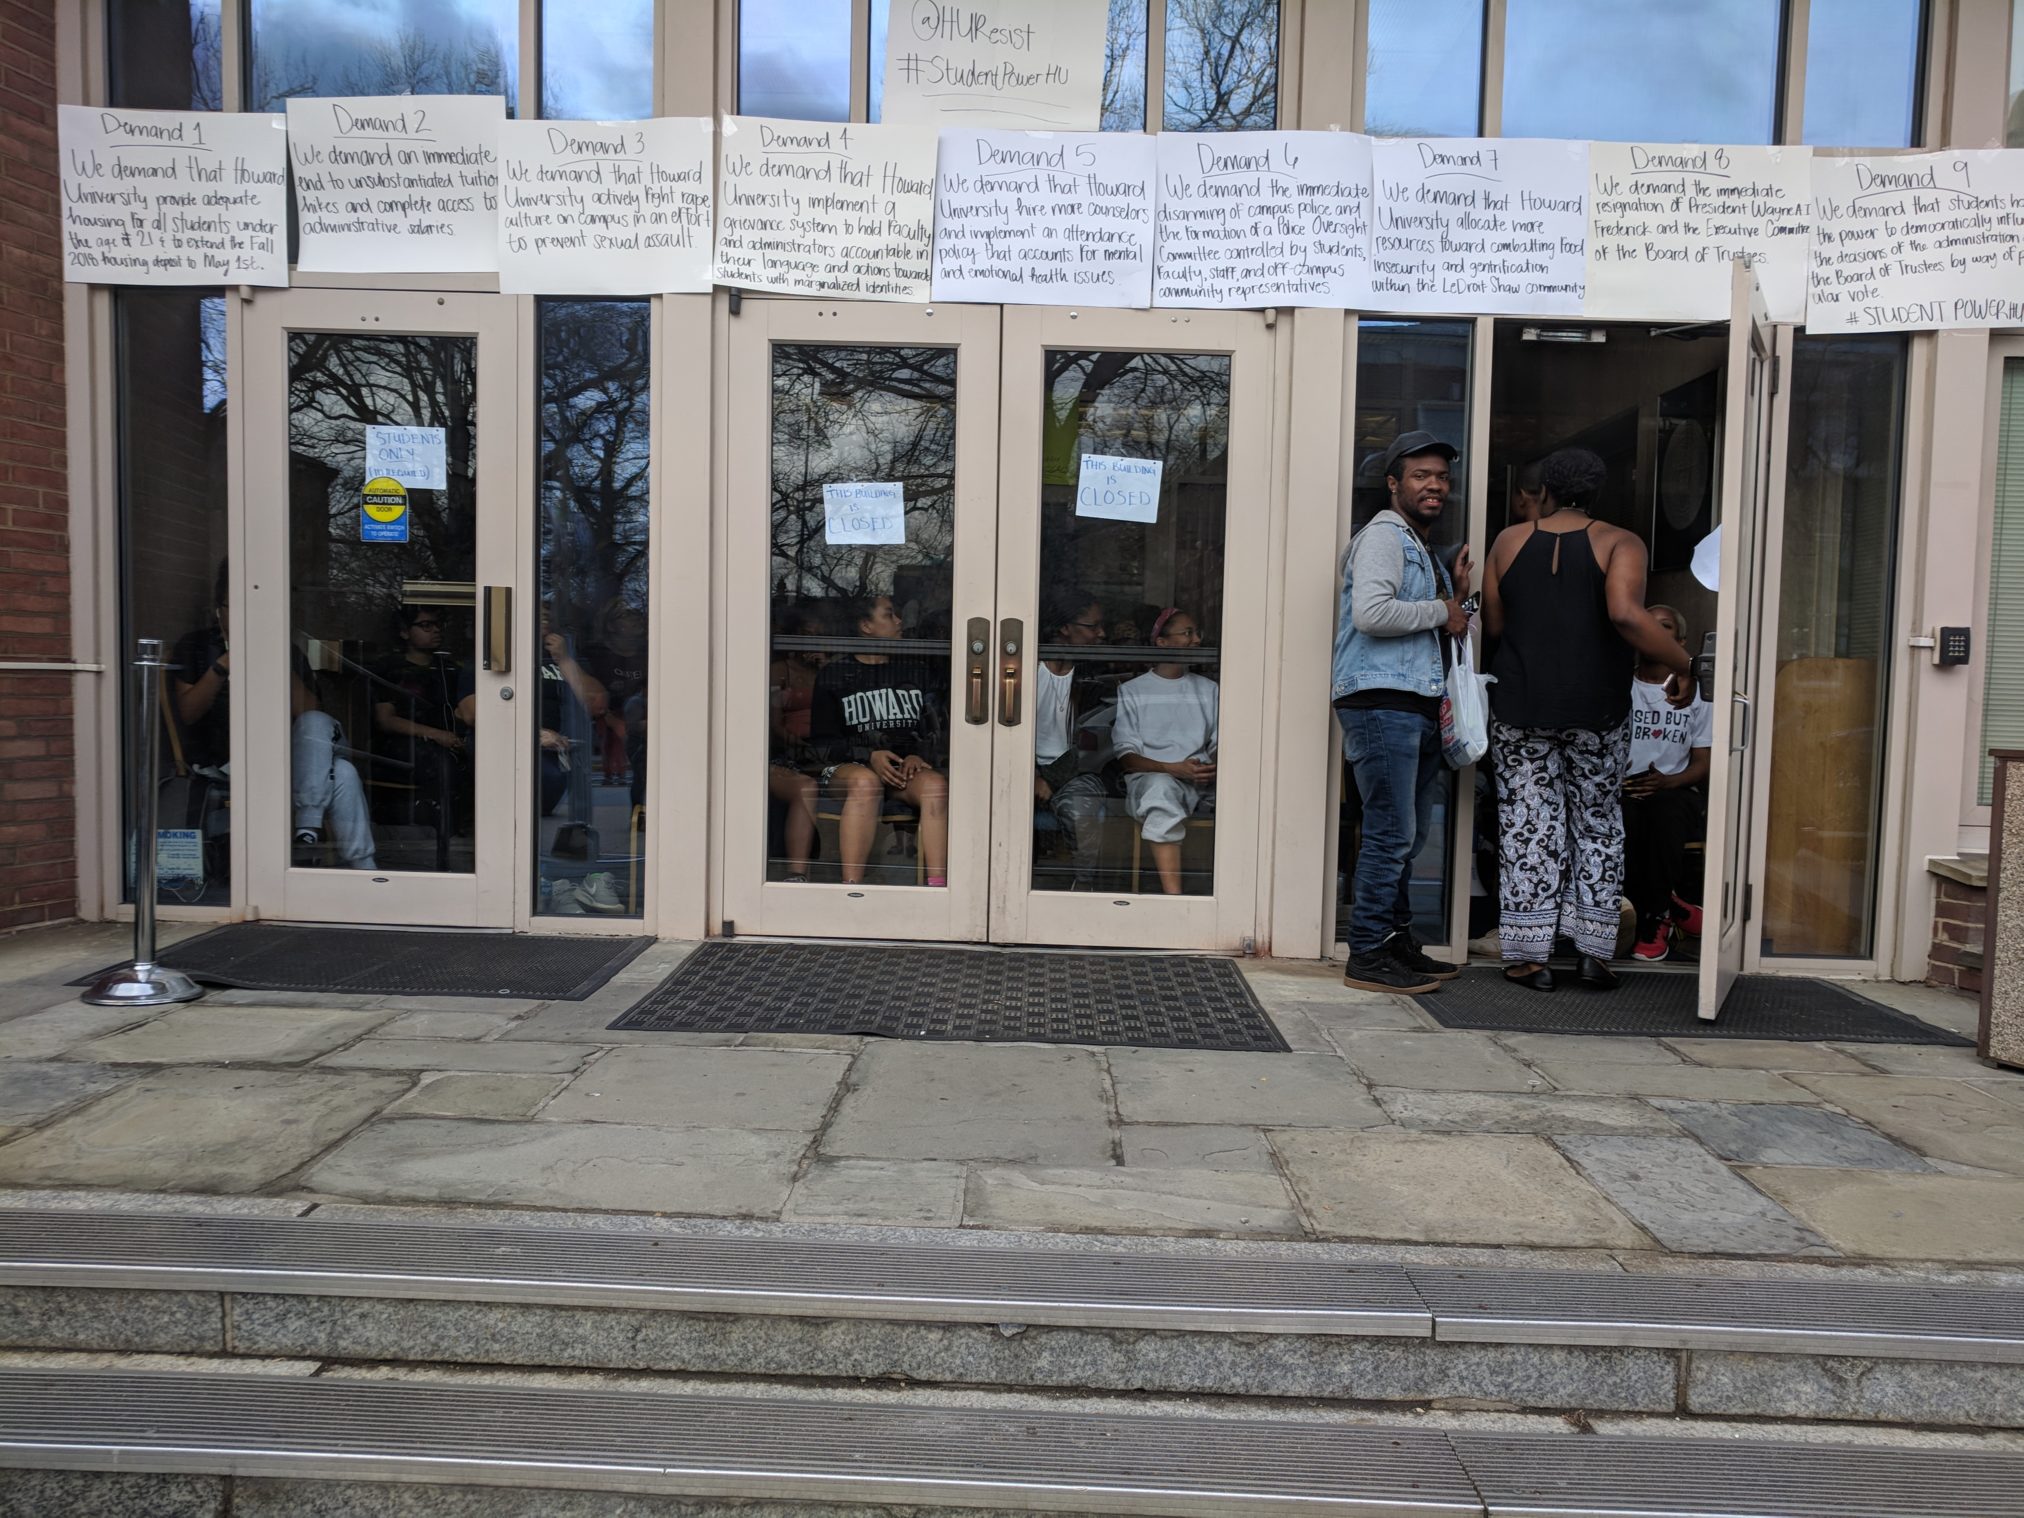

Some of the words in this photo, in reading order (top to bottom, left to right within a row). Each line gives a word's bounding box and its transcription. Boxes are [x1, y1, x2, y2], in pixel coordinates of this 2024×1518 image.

[912, 0, 1036, 51] @HUResist
[101, 113, 183, 141] Demand
[192, 122, 206, 145] 1
[332, 104, 408, 134] Demand
[414, 110, 432, 133] 2
[548, 128, 626, 155] Demand
[635, 132, 645, 154] 3
[761, 125, 829, 149] Demand
[839, 127, 854, 150] 4
[293, 142, 323, 165] We
[329, 143, 393, 166] demand
[398, 149, 418, 165] an
[423, 143, 497, 165] immediate
[977, 139, 1065, 170] Demand
[1076, 143, 1096, 167] 5
[1198, 142, 1270, 174] Demand
[1285, 142, 1299, 170] 6
[1418, 143, 1482, 169] Demand
[1487, 149, 1498, 170] 7
[1631, 146, 1707, 170] Demand
[1715, 148, 1730, 170] 8
[71, 149, 104, 178] We
[112, 156, 175, 180] demand
[185, 156, 224, 182] that
[235, 157, 285, 186] Howard
[507, 160, 530, 182] We
[537, 162, 602, 184] demand
[609, 163, 643, 185] that
[650, 160, 702, 184] Howard
[726, 154, 753, 177] We
[759, 158, 831, 182] demand
[838, 160, 873, 188] that
[882, 161, 933, 200] Howard
[1856, 163, 1936, 190] Demand
[1953, 161, 1970, 188] 9
[64, 179, 147, 209] University
[156, 193, 196, 212] provide
[203, 190, 261, 211] adequate
[943, 173, 969, 193] We
[974, 174, 1039, 195] demand
[1047, 173, 1080, 195] that
[1088, 173, 1145, 200] Howard
[1165, 173, 1192, 200] We
[1198, 177, 1260, 198] demand
[1270, 179, 1292, 198] the
[1297, 181, 1370, 198] immediate
[1383, 179, 1409, 203] We
[1416, 182, 1475, 209] demand
[1484, 190, 1510, 211] that
[1521, 190, 1582, 215] Howard
[1595, 173, 1623, 196] We
[1629, 177, 1685, 195] demand
[1692, 179, 1712, 198] the
[1717, 181, 1786, 198] immediate
[301, 196, 339, 213] hikes
[346, 198, 373, 213] and
[377, 194, 431, 218] complete
[438, 197, 474, 213] access
[483, 192, 497, 210] to
[504, 185, 584, 218] University
[592, 188, 640, 213] actively
[681, 192, 710, 212] rape
[724, 181, 800, 216] University
[809, 192, 877, 214] implement
[884, 201, 895, 218] a
[940, 199, 1008, 225] University
[1017, 198, 1047, 216] hire
[1052, 203, 1083, 216] more
[1088, 203, 1149, 224] counselors
[1816, 197, 1843, 221] We
[1846, 201, 1905, 218] demand
[1912, 195, 1940, 214] that
[1948, 194, 2006, 211] students
[303, 217, 400, 235] administrative
[940, 224, 965, 239] and
[970, 224, 1036, 245] implement
[1043, 227, 1058, 239] an
[1064, 225, 1137, 246] attendance
[1378, 207, 1449, 239] University
[1457, 211, 1507, 232] allocate
[1512, 220, 1544, 234] more
[1595, 220, 1652, 238] Frederick
[1657, 220, 1678, 235] and
[1684, 223, 1700, 235] the
[1707, 218, 1759, 238] Executive
[506, 234, 527, 253] to
[535, 229, 588, 255] prevent
[594, 232, 639, 250] sexual
[720, 236, 743, 249] and
[747, 237, 835, 257] administrators
[841, 243, 913, 260] accountable
[916, 248, 928, 260] in
[1160, 246, 1220, 262] Committee
[1225, 242, 1284, 260] controlled
[1290, 244, 1307, 266] by
[1313, 240, 1366, 261] students,
[68, 253, 99, 267] 2018
[102, 252, 149, 274] housing
[187, 256, 196, 269] to
[203, 255, 229, 276] May
[1374, 253, 1435, 282] insecurity
[1442, 258, 1464, 273] and
[1470, 258, 1548, 278] gentrification
[767, 272, 788, 285] with
[794, 276, 860, 292] marginalized
[1159, 284, 1223, 303] community
[1864, 301, 1946, 325] STUDENT
[376, 432, 442, 445] STUDENTS
[379, 447, 414, 460] ONLY
[1083, 460, 1106, 470] THIS
[1113, 461, 1156, 476] BUILDING
[1107, 475, 1117, 485] IS
[367, 496, 403, 504] CAUTION
[826, 489, 852, 498] THIS
[856, 489, 895, 498] BUILDING
[1081, 487, 1150, 506] CLOSED
[828, 517, 893, 534] CLOSED
[842, 688, 923, 726] HOWARD
[1665, 711, 1690, 728] BUT
